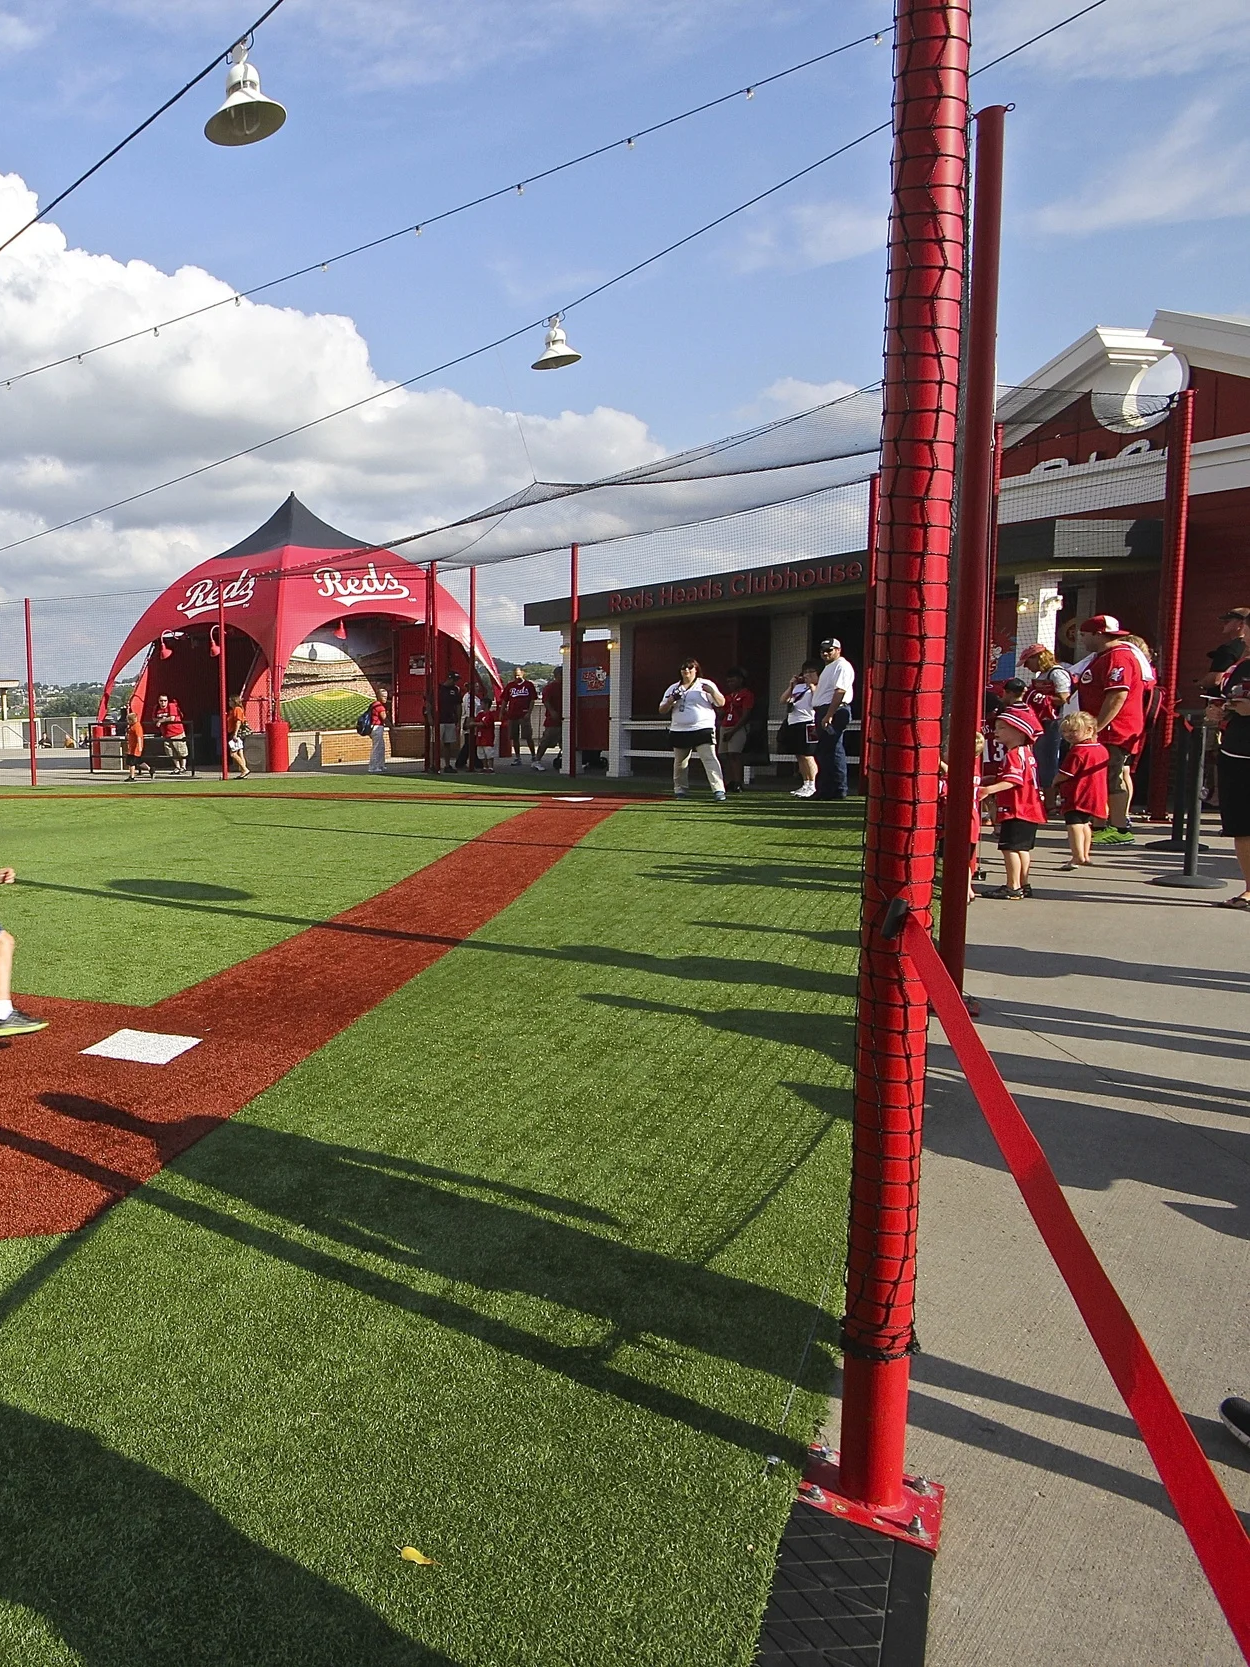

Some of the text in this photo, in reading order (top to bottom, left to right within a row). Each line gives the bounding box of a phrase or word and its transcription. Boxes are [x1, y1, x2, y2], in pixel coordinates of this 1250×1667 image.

[176, 568, 258, 620] Reds
[313, 562, 411, 608] Reds
[610, 561, 863, 612] Reds Heads Clubhouse
[510, 686, 530, 698] Reds
[983, 739, 1005, 763] 13
